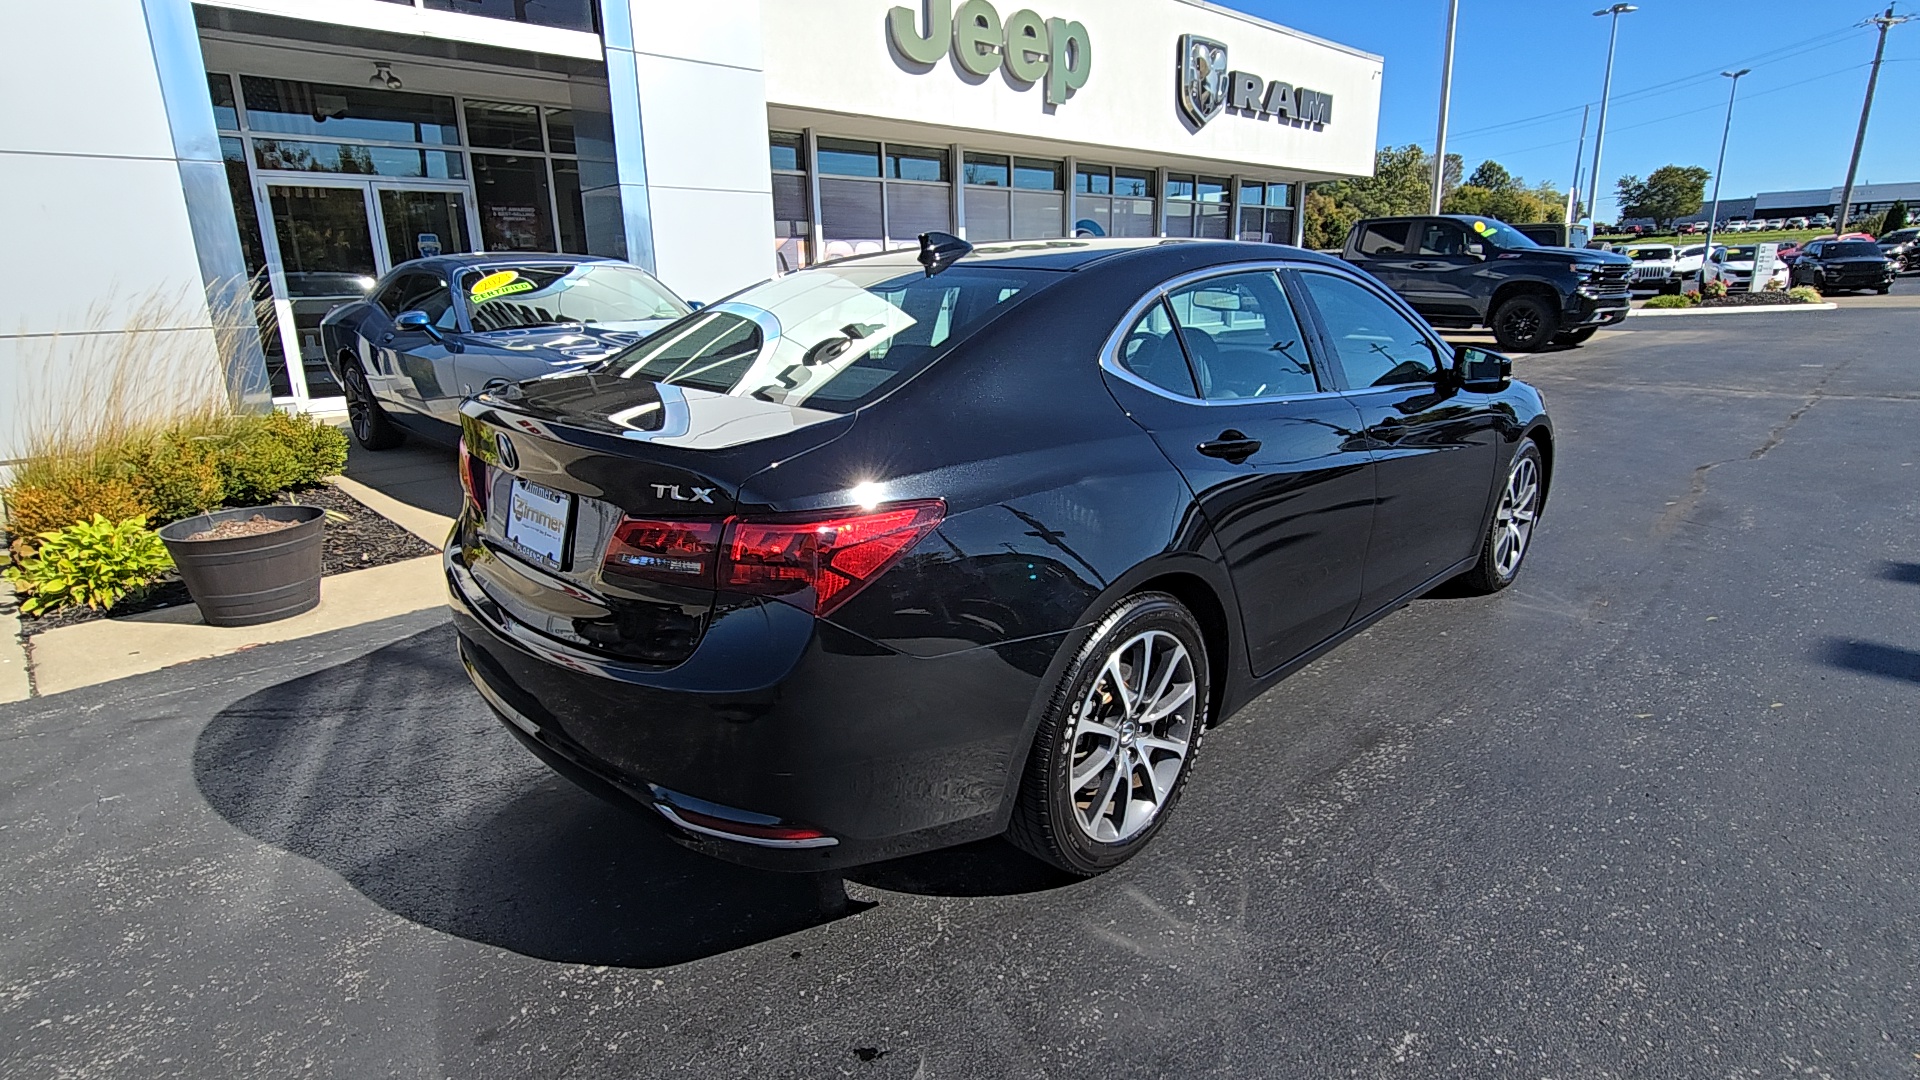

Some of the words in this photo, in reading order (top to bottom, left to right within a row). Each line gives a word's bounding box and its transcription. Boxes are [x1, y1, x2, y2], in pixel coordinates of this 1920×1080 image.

[887, 0, 1092, 105] Jeep
[1228, 71, 1333, 126] RAM
[473, 283, 528, 302] CERTIFIED
[525, 480, 553, 500] Zimmer
[650, 483, 717, 505] TLX
